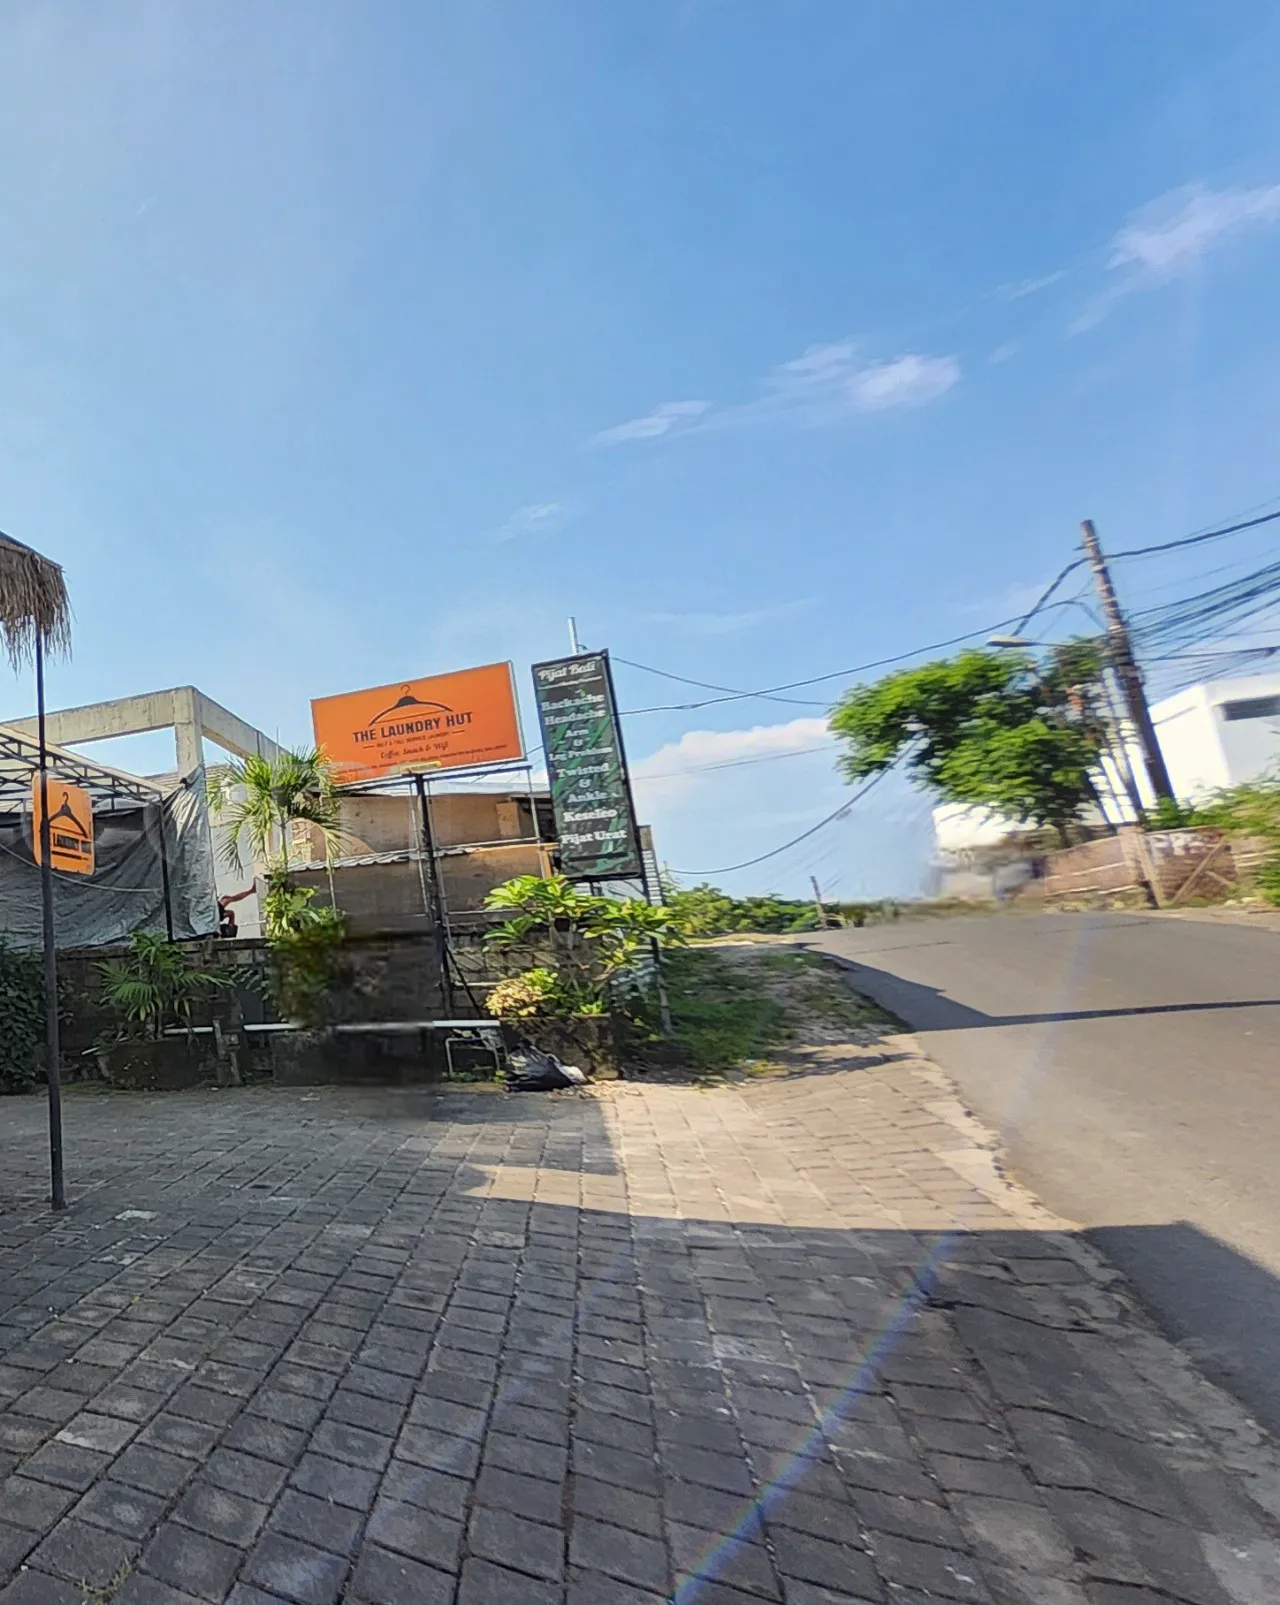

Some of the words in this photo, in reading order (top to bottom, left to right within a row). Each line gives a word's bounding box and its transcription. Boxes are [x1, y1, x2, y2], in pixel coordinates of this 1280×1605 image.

[353, 728, 376, 743] THE
[380, 717, 441, 738] LAUNDRY
[445, 711, 473, 728] HUT
